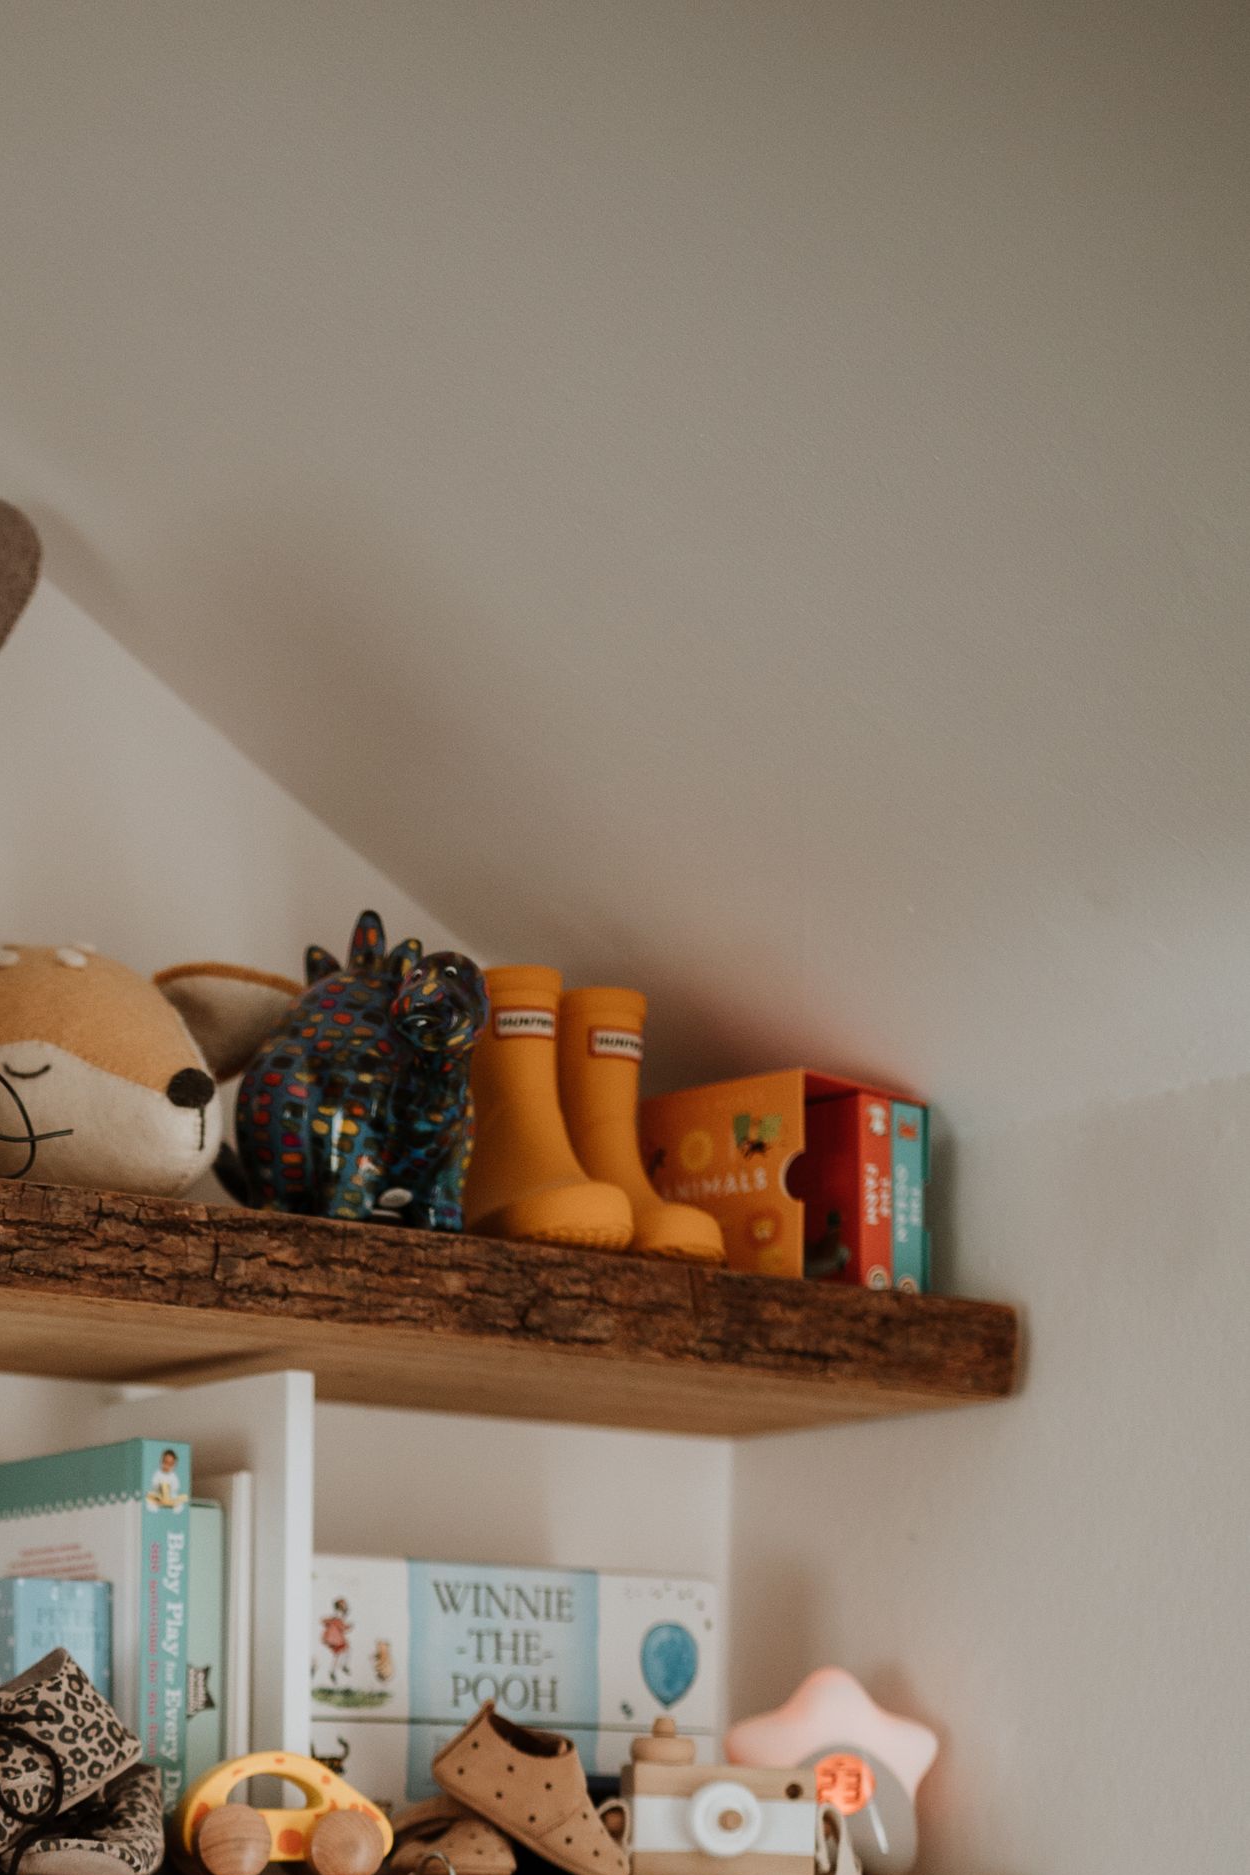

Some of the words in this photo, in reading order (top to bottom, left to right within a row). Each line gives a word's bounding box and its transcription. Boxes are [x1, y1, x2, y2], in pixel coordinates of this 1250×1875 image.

[162, 1530, 186, 1595] Baby
[161, 1601, 185, 1658] Play
[433, 1579, 576, 1623] WINNIE
[451, 1672, 559, 1714] POOH
[160, 1688, 182, 1762] Every
